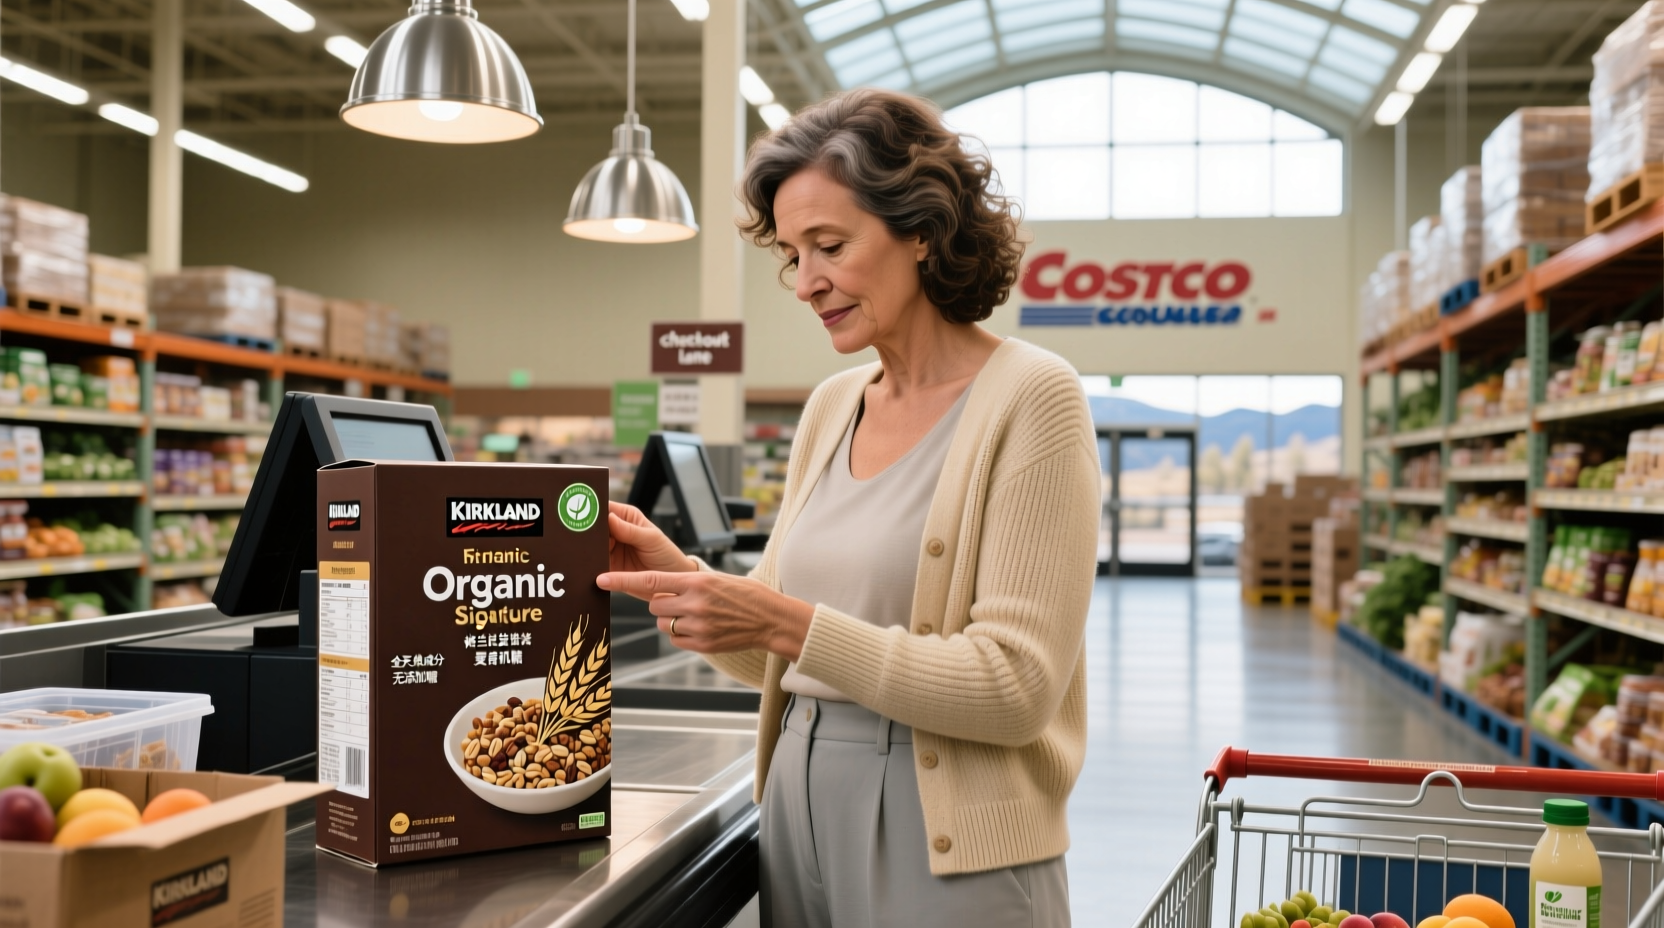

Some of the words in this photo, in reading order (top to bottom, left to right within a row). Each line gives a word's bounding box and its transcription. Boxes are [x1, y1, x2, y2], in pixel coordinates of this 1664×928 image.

[658, 330, 731, 349] checkout
[451, 501, 541, 521] KIRKLAND
[423, 563, 566, 609] Organic
